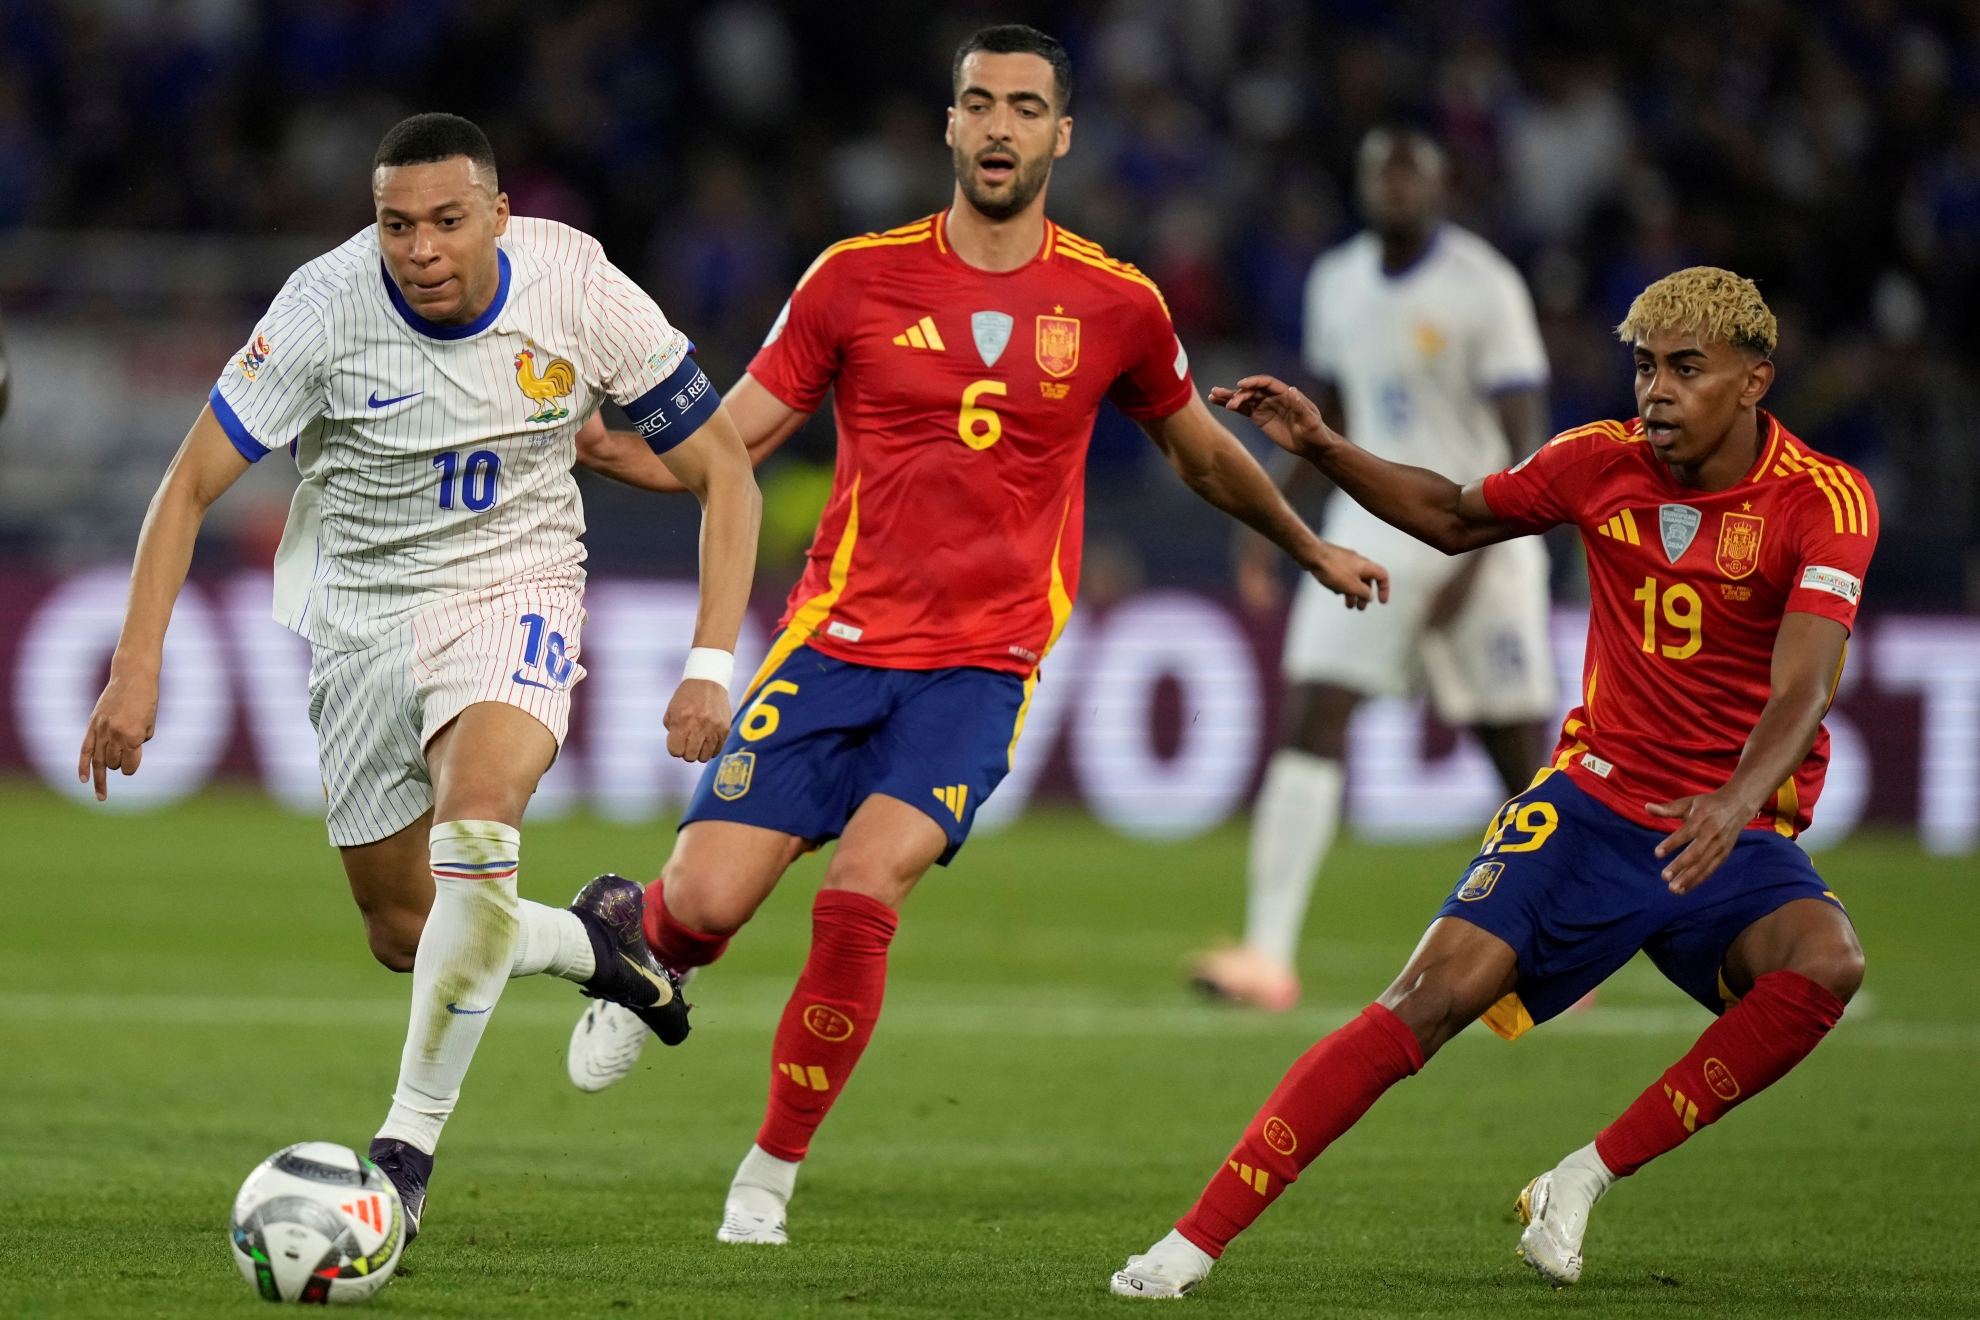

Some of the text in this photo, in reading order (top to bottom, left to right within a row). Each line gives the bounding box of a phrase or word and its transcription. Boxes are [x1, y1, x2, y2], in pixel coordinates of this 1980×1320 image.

[635, 411, 667, 435] PECT
[958, 379, 1007, 450] 6
[433, 450, 501, 513] 10
[1663, 510, 1697, 522] EUROPEAN
[1667, 540, 1684, 550] 2024
[1804, 573, 1850, 589] FOUNDATION
[1634, 576, 1702, 660] 19
[739, 679, 799, 742] 6
[1484, 801, 1559, 855] 19
